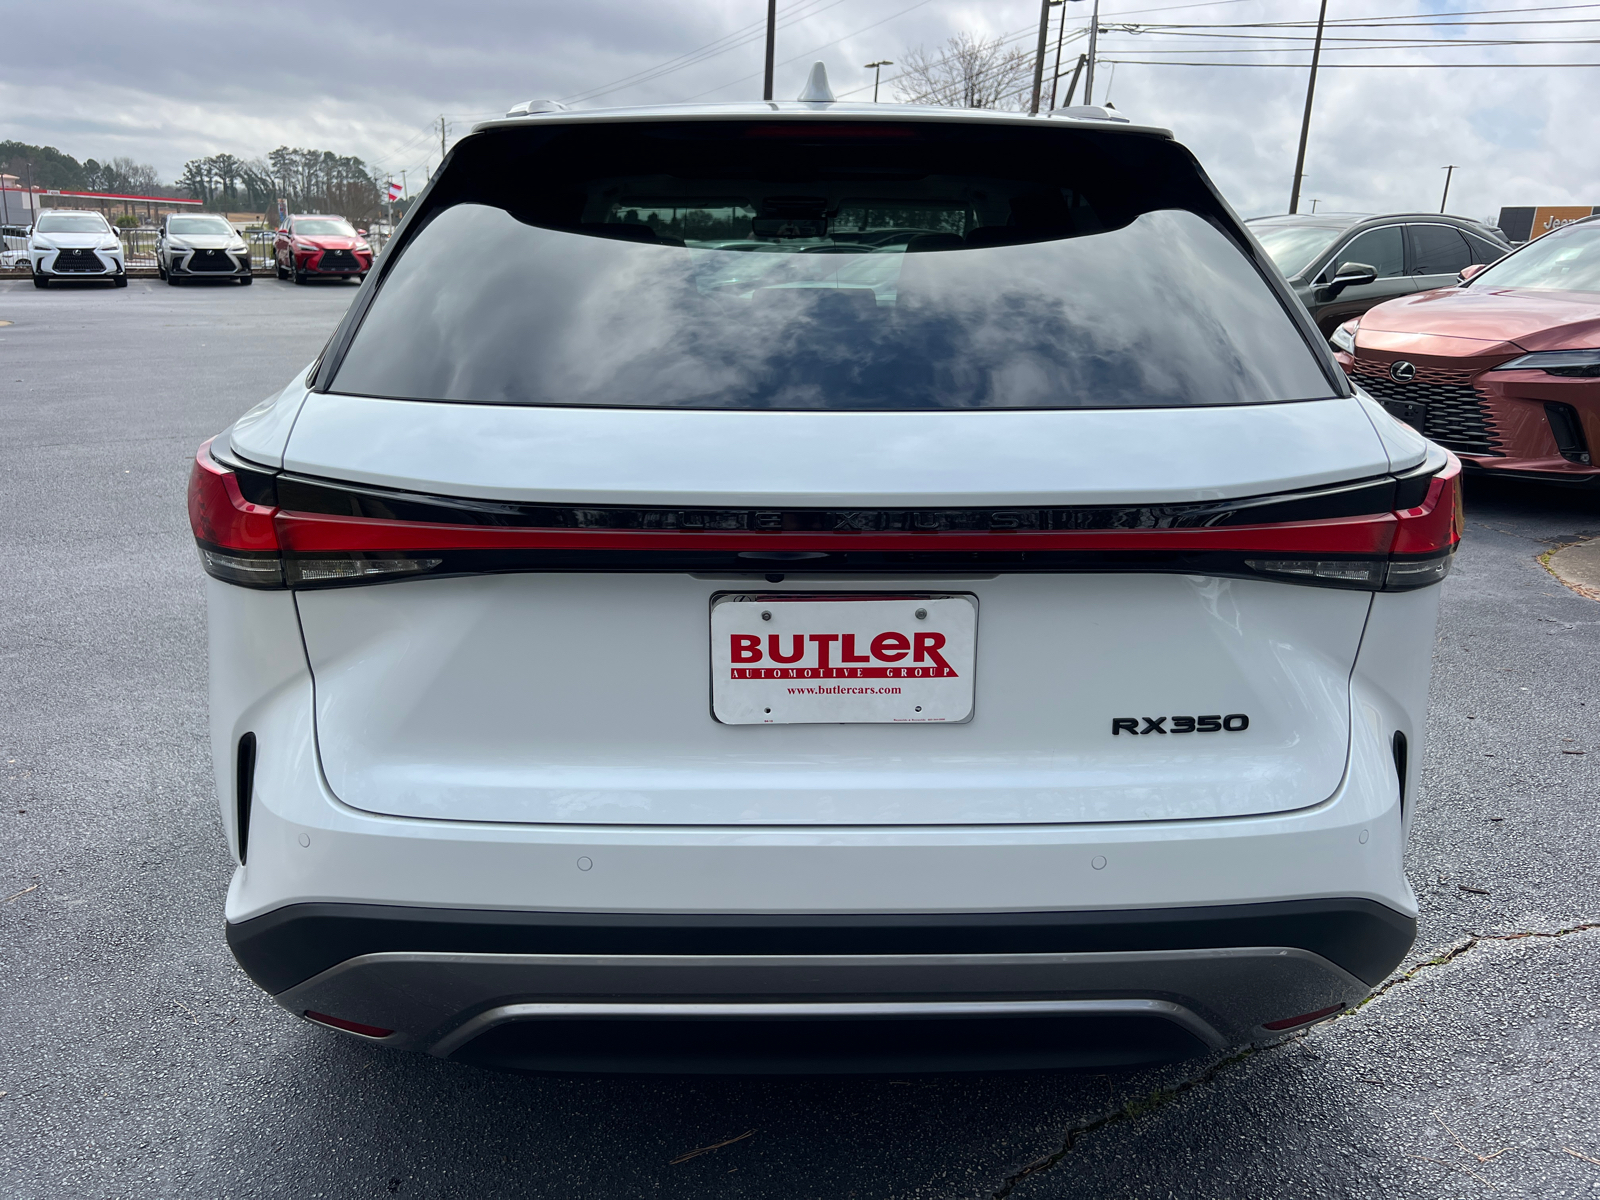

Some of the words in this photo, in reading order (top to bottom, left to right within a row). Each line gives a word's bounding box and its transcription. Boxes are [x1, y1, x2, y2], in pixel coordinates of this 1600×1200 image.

[678, 511, 1019, 530] LEXUS
[732, 668, 863, 679] AUTOMOTIVE
[886, 667, 950, 678] GROUP
[787, 685, 902, 695] www.butlercars.com
